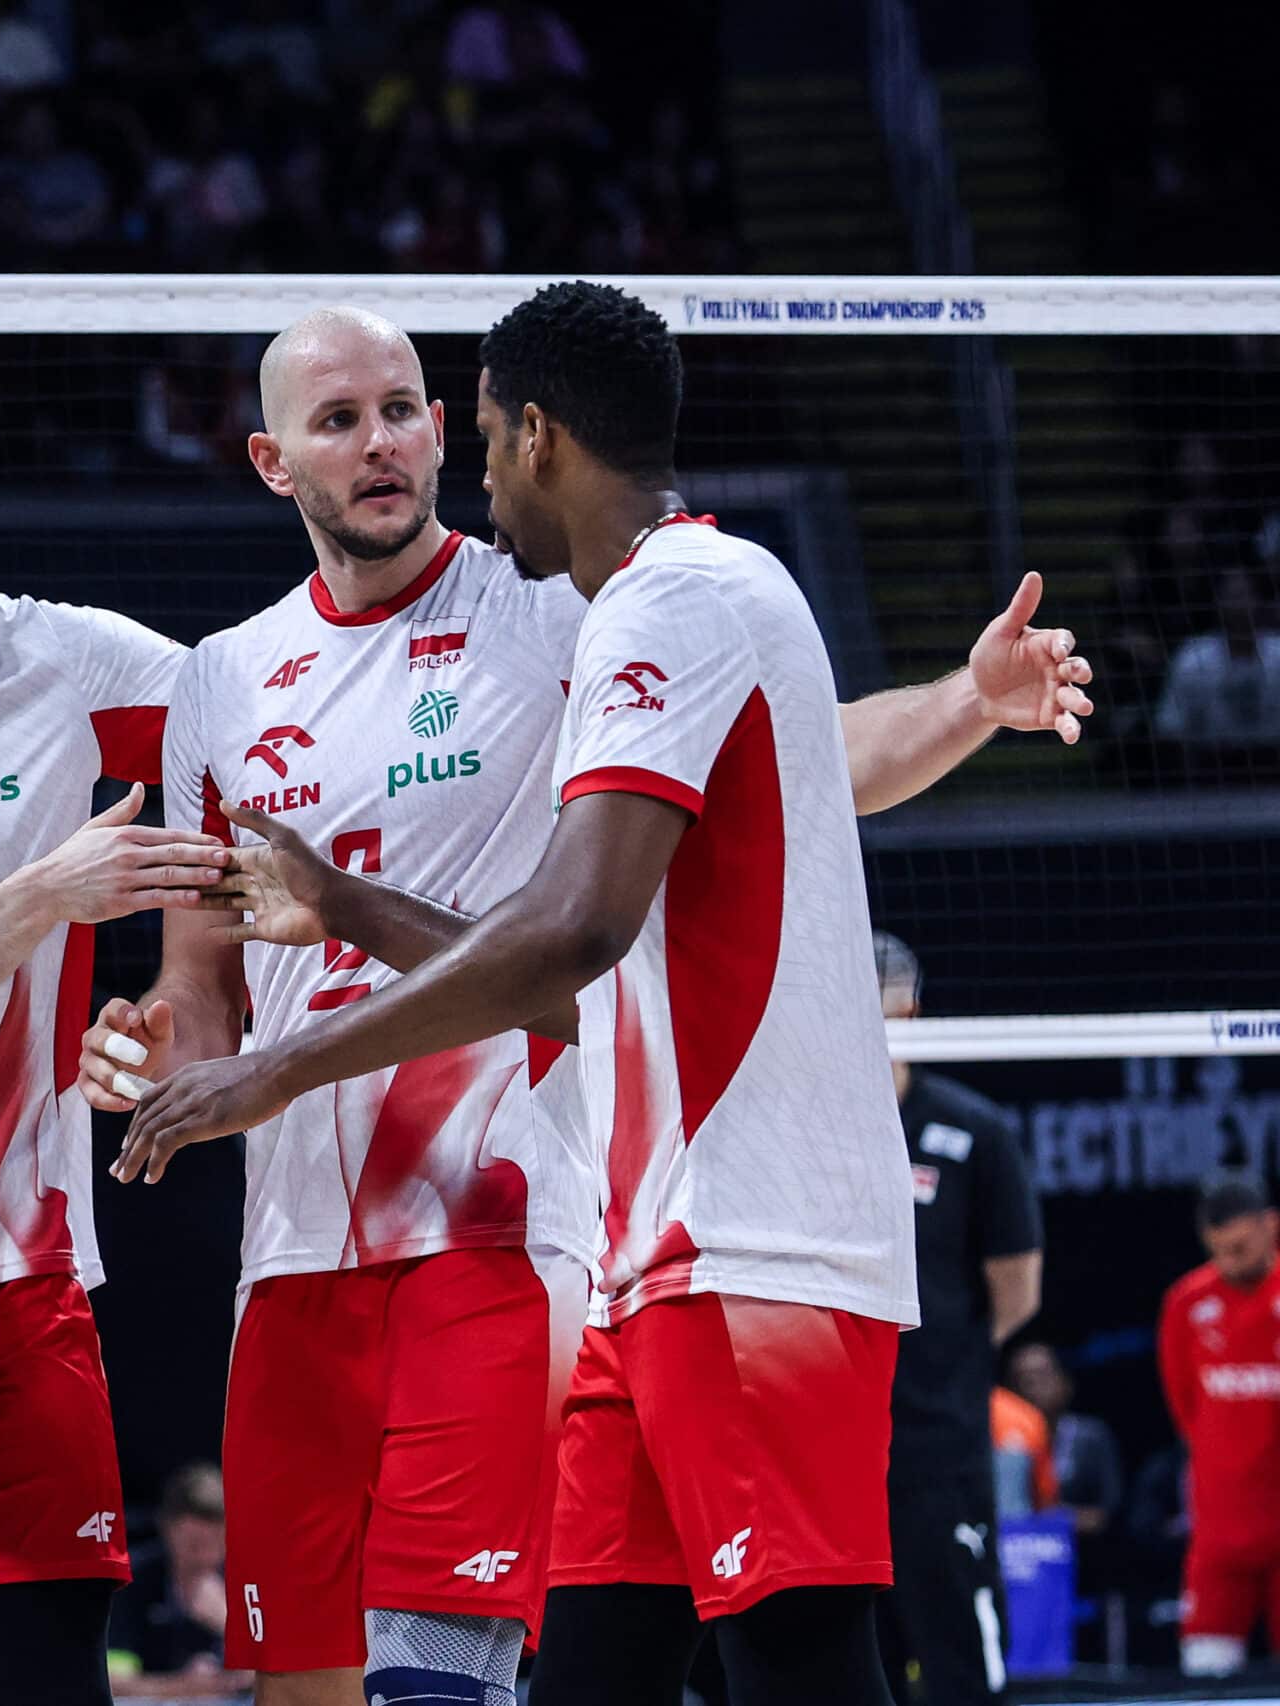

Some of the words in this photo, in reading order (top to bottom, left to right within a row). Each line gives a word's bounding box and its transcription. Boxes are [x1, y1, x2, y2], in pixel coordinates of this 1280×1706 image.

[701, 300, 780, 320] VOLLEYBALL
[787, 300, 838, 320] WORLD
[842, 300, 945, 320] CHAMPIONSHIP
[409, 651, 462, 672] POLSKA
[387, 749, 482, 798] plus
[76, 1511, 116, 1543] 4F
[453, 1549, 520, 1583] 4F
[243, 1583, 264, 1643] 6
